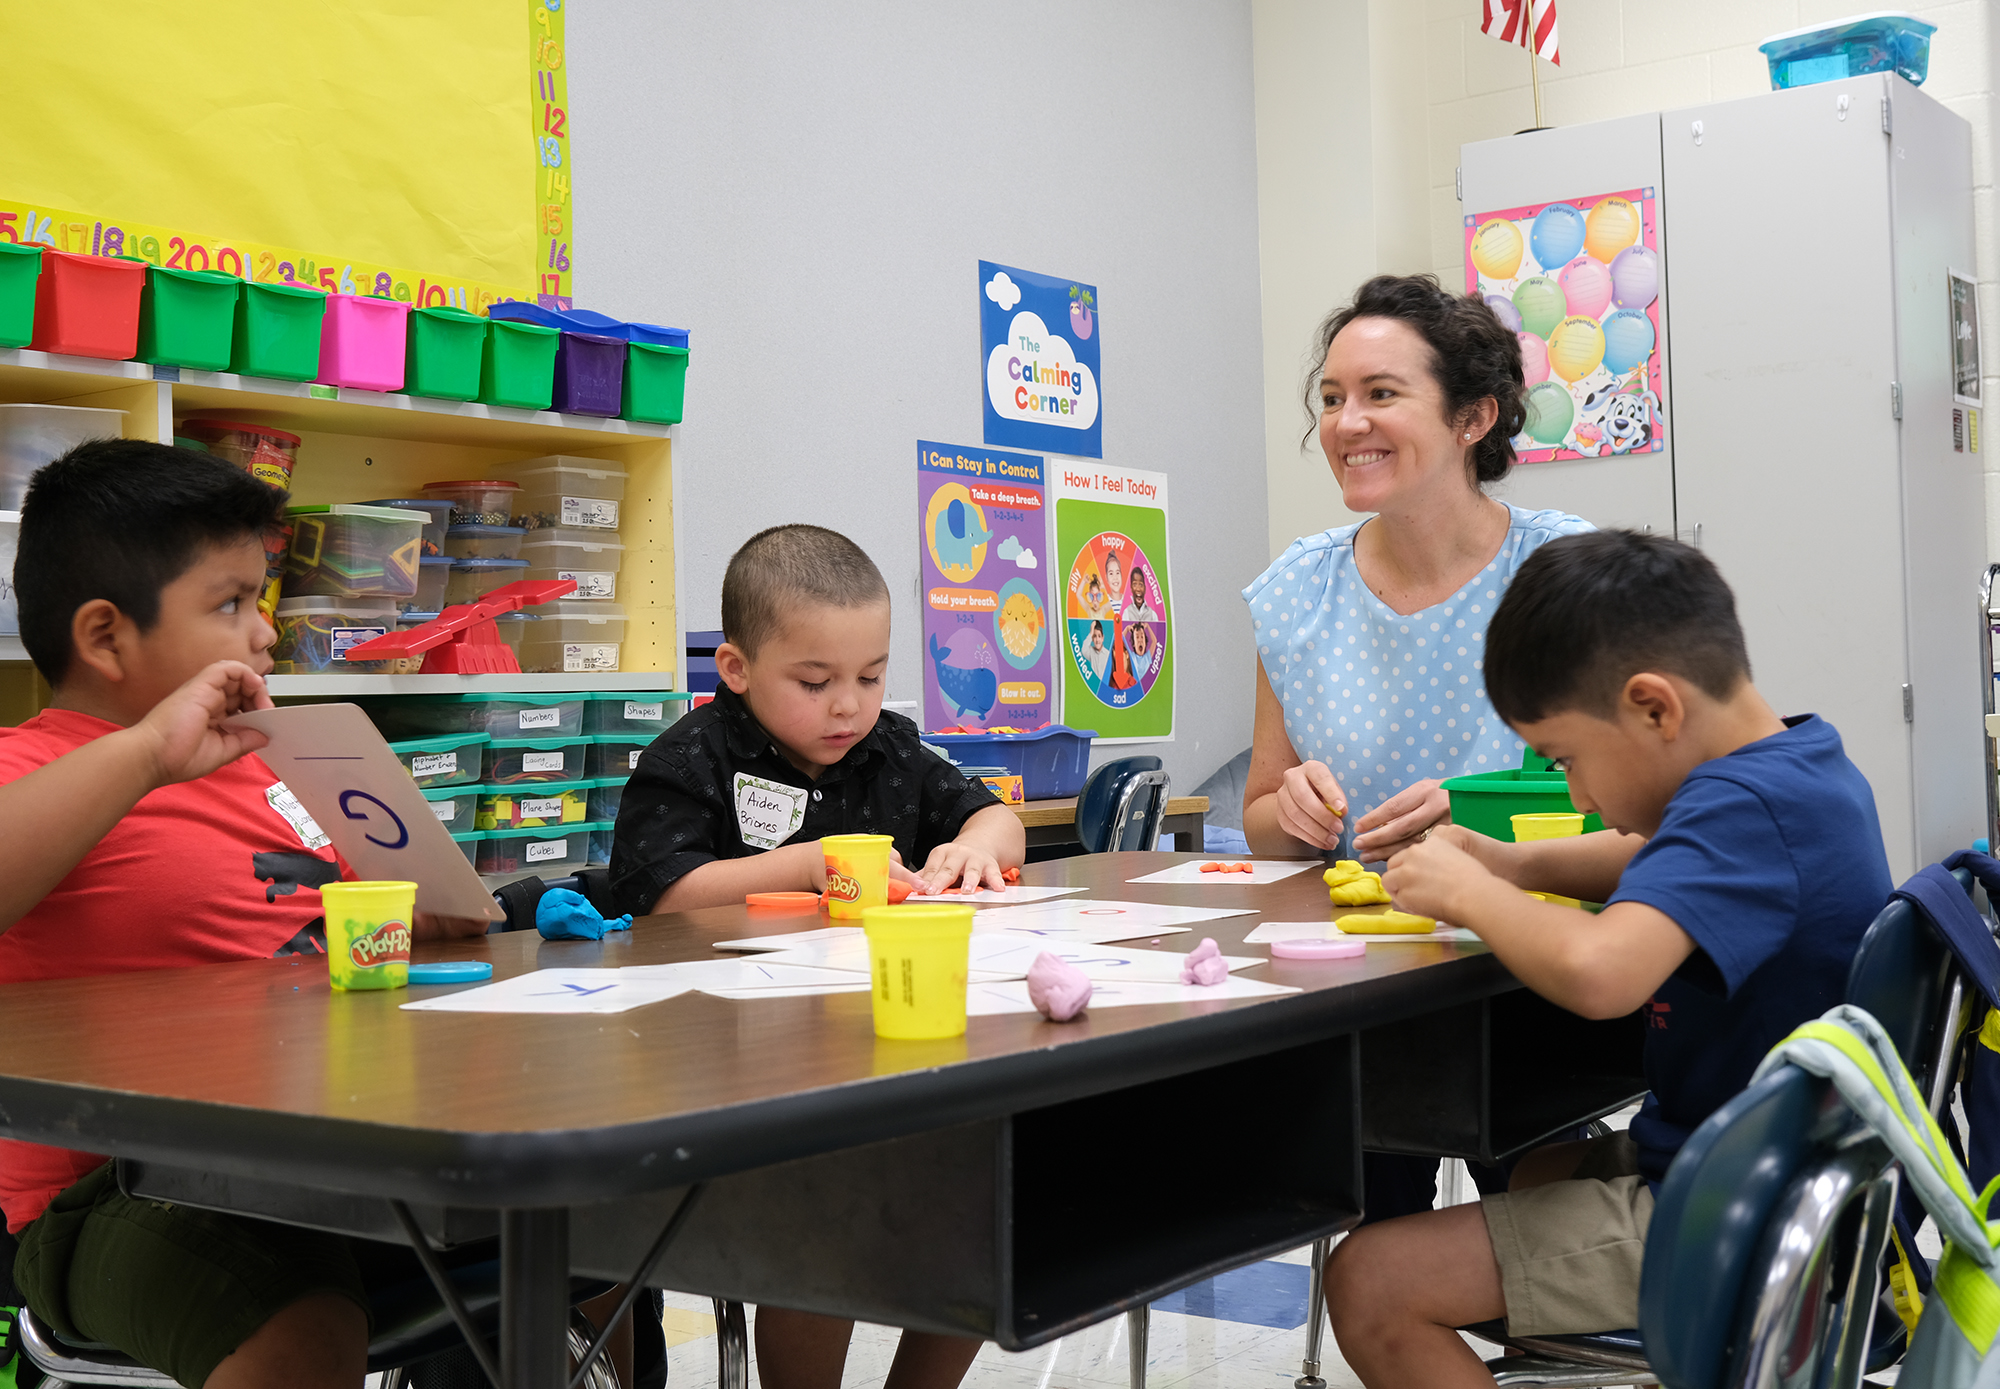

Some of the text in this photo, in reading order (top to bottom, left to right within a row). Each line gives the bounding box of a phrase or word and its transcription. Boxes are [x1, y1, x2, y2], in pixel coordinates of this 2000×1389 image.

[535, 7, 551, 38] 9
[536, 34, 562, 70] 10
[538, 70, 555, 101] 11
[544, 103, 566, 138] 12
[539, 136, 562, 168] 13
[546, 169, 569, 204] 14
[1549, 206, 1575, 217] February
[1608, 200, 1627, 208] March
[541, 204, 563, 235] 15
[1478, 221, 1500, 238] January
[548, 238, 570, 272] 16
[1632, 248, 1645, 256] July
[60, 222, 88, 254] 17
[92, 221, 124, 257] 18
[130, 234, 160, 267] 19
[416, 278, 446, 309] 10
[1573, 259, 1587, 268] June
[541, 273, 560, 296] 17
[1565, 319, 1597, 330] September
[1617, 311, 1642, 321] October
[1019, 336, 1040, 353] The
[1008, 356, 1081, 395] Calming
[1530, 384, 1552, 396] cember
[1015, 386, 1077, 415] Corner
[923, 451, 1040, 479] I Can Stay in Control
[1064, 471, 1157, 500] How I Feel Today
[972, 489, 1041, 506] Take a deep breath.
[1101, 535, 1125, 551] happy
[1071, 568, 1081, 593] silly
[1142, 563, 1162, 605] excited
[931, 594, 997, 607] Hold your breath.
[1071, 633, 1092, 680] worried
[1150, 642, 1163, 674] upset
[1001, 688, 1041, 698] Blow it out.
[1113, 692, 1126, 704] sad
[521, 713, 554, 723] Numbers
[627, 704, 656, 717] Shapes
[414, 755, 443, 764] Alphabet
[414, 763, 435, 771] Number
[525, 755, 545, 766] Lacing
[523, 802, 542, 812] Plane
[747, 791, 782, 812] Aiden
[741, 810, 777, 833] Briones
[529, 845, 555, 856] Cubes
[352, 929, 410, 962] Play-Do
